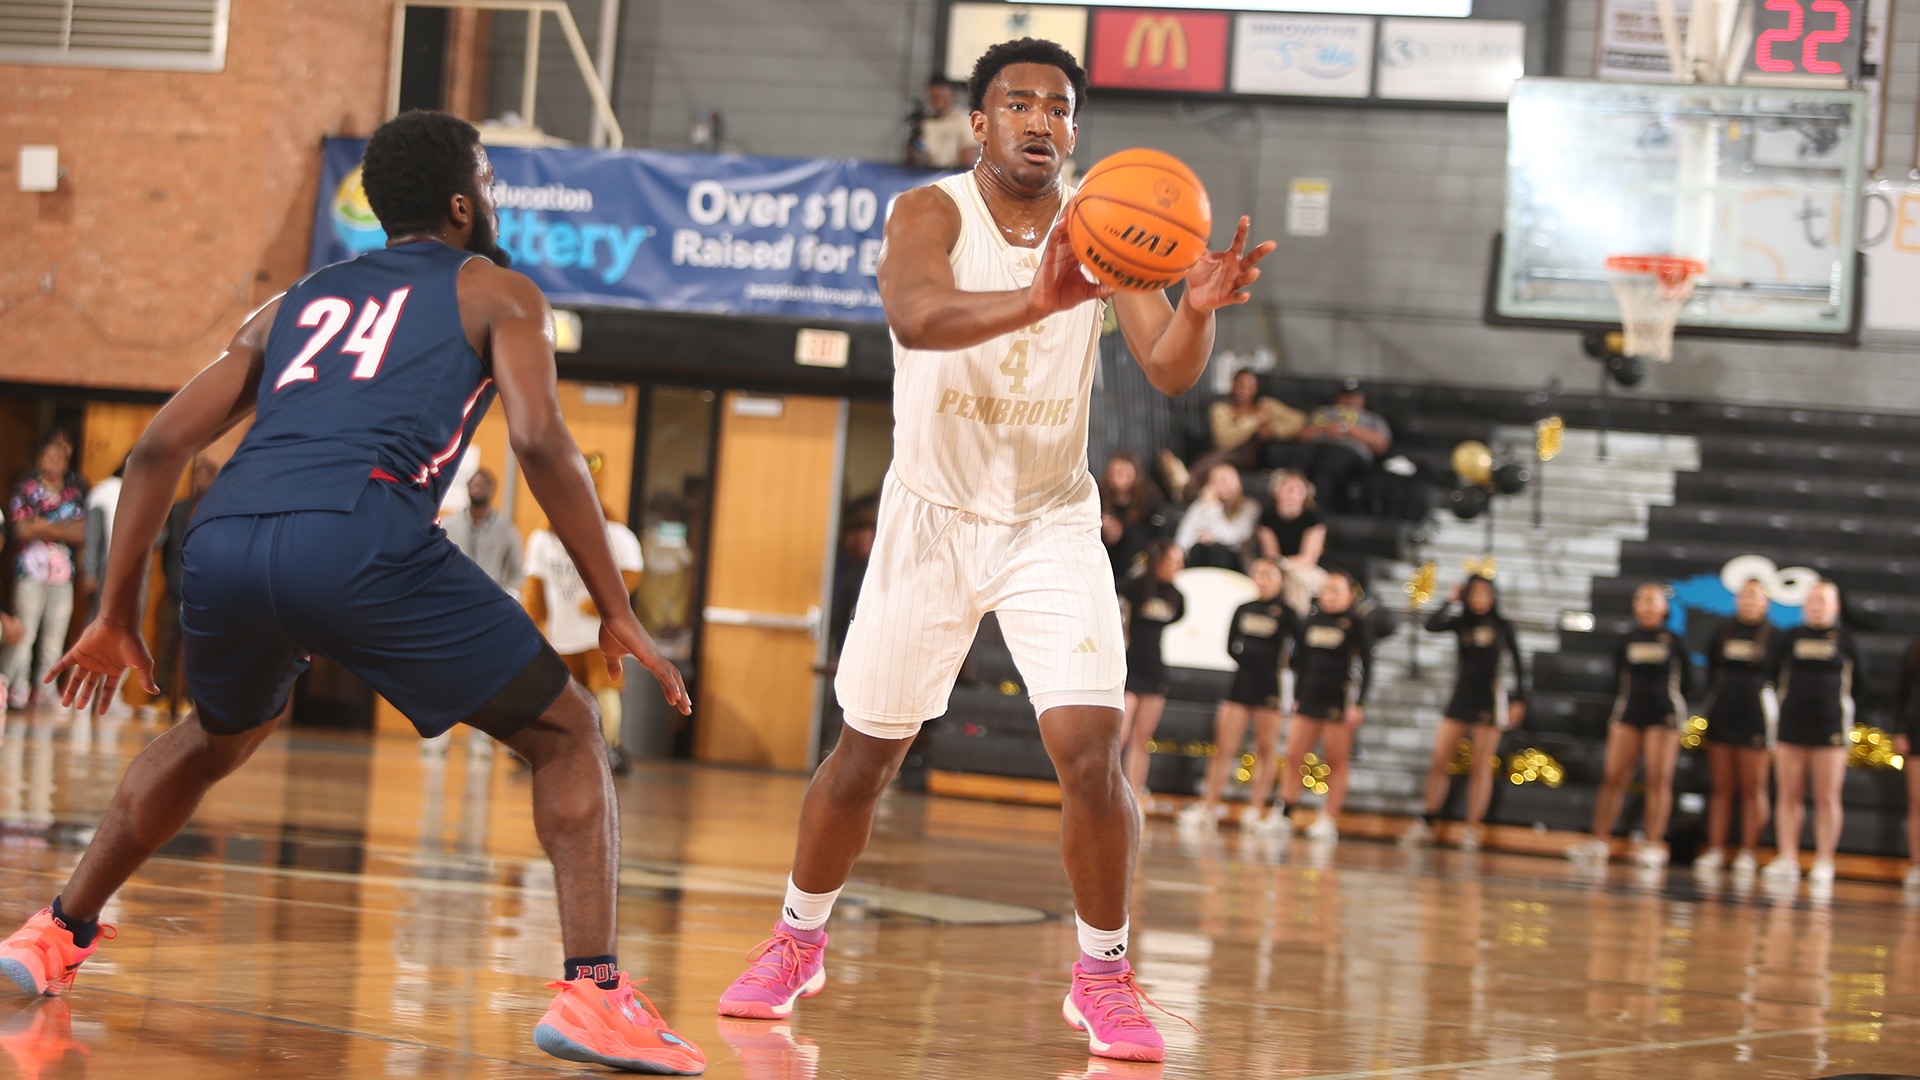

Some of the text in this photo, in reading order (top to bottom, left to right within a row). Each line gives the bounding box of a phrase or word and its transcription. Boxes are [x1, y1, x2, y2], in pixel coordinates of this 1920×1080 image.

[1755, 0, 1850, 73] 22
[687, 179, 878, 233] Over $10
[672, 228, 795, 270] Raised
[799, 233, 856, 274] for
[274, 285, 413, 393] 24
[999, 339, 1030, 394] 4
[936, 387, 1075, 427] PEMBROKE
